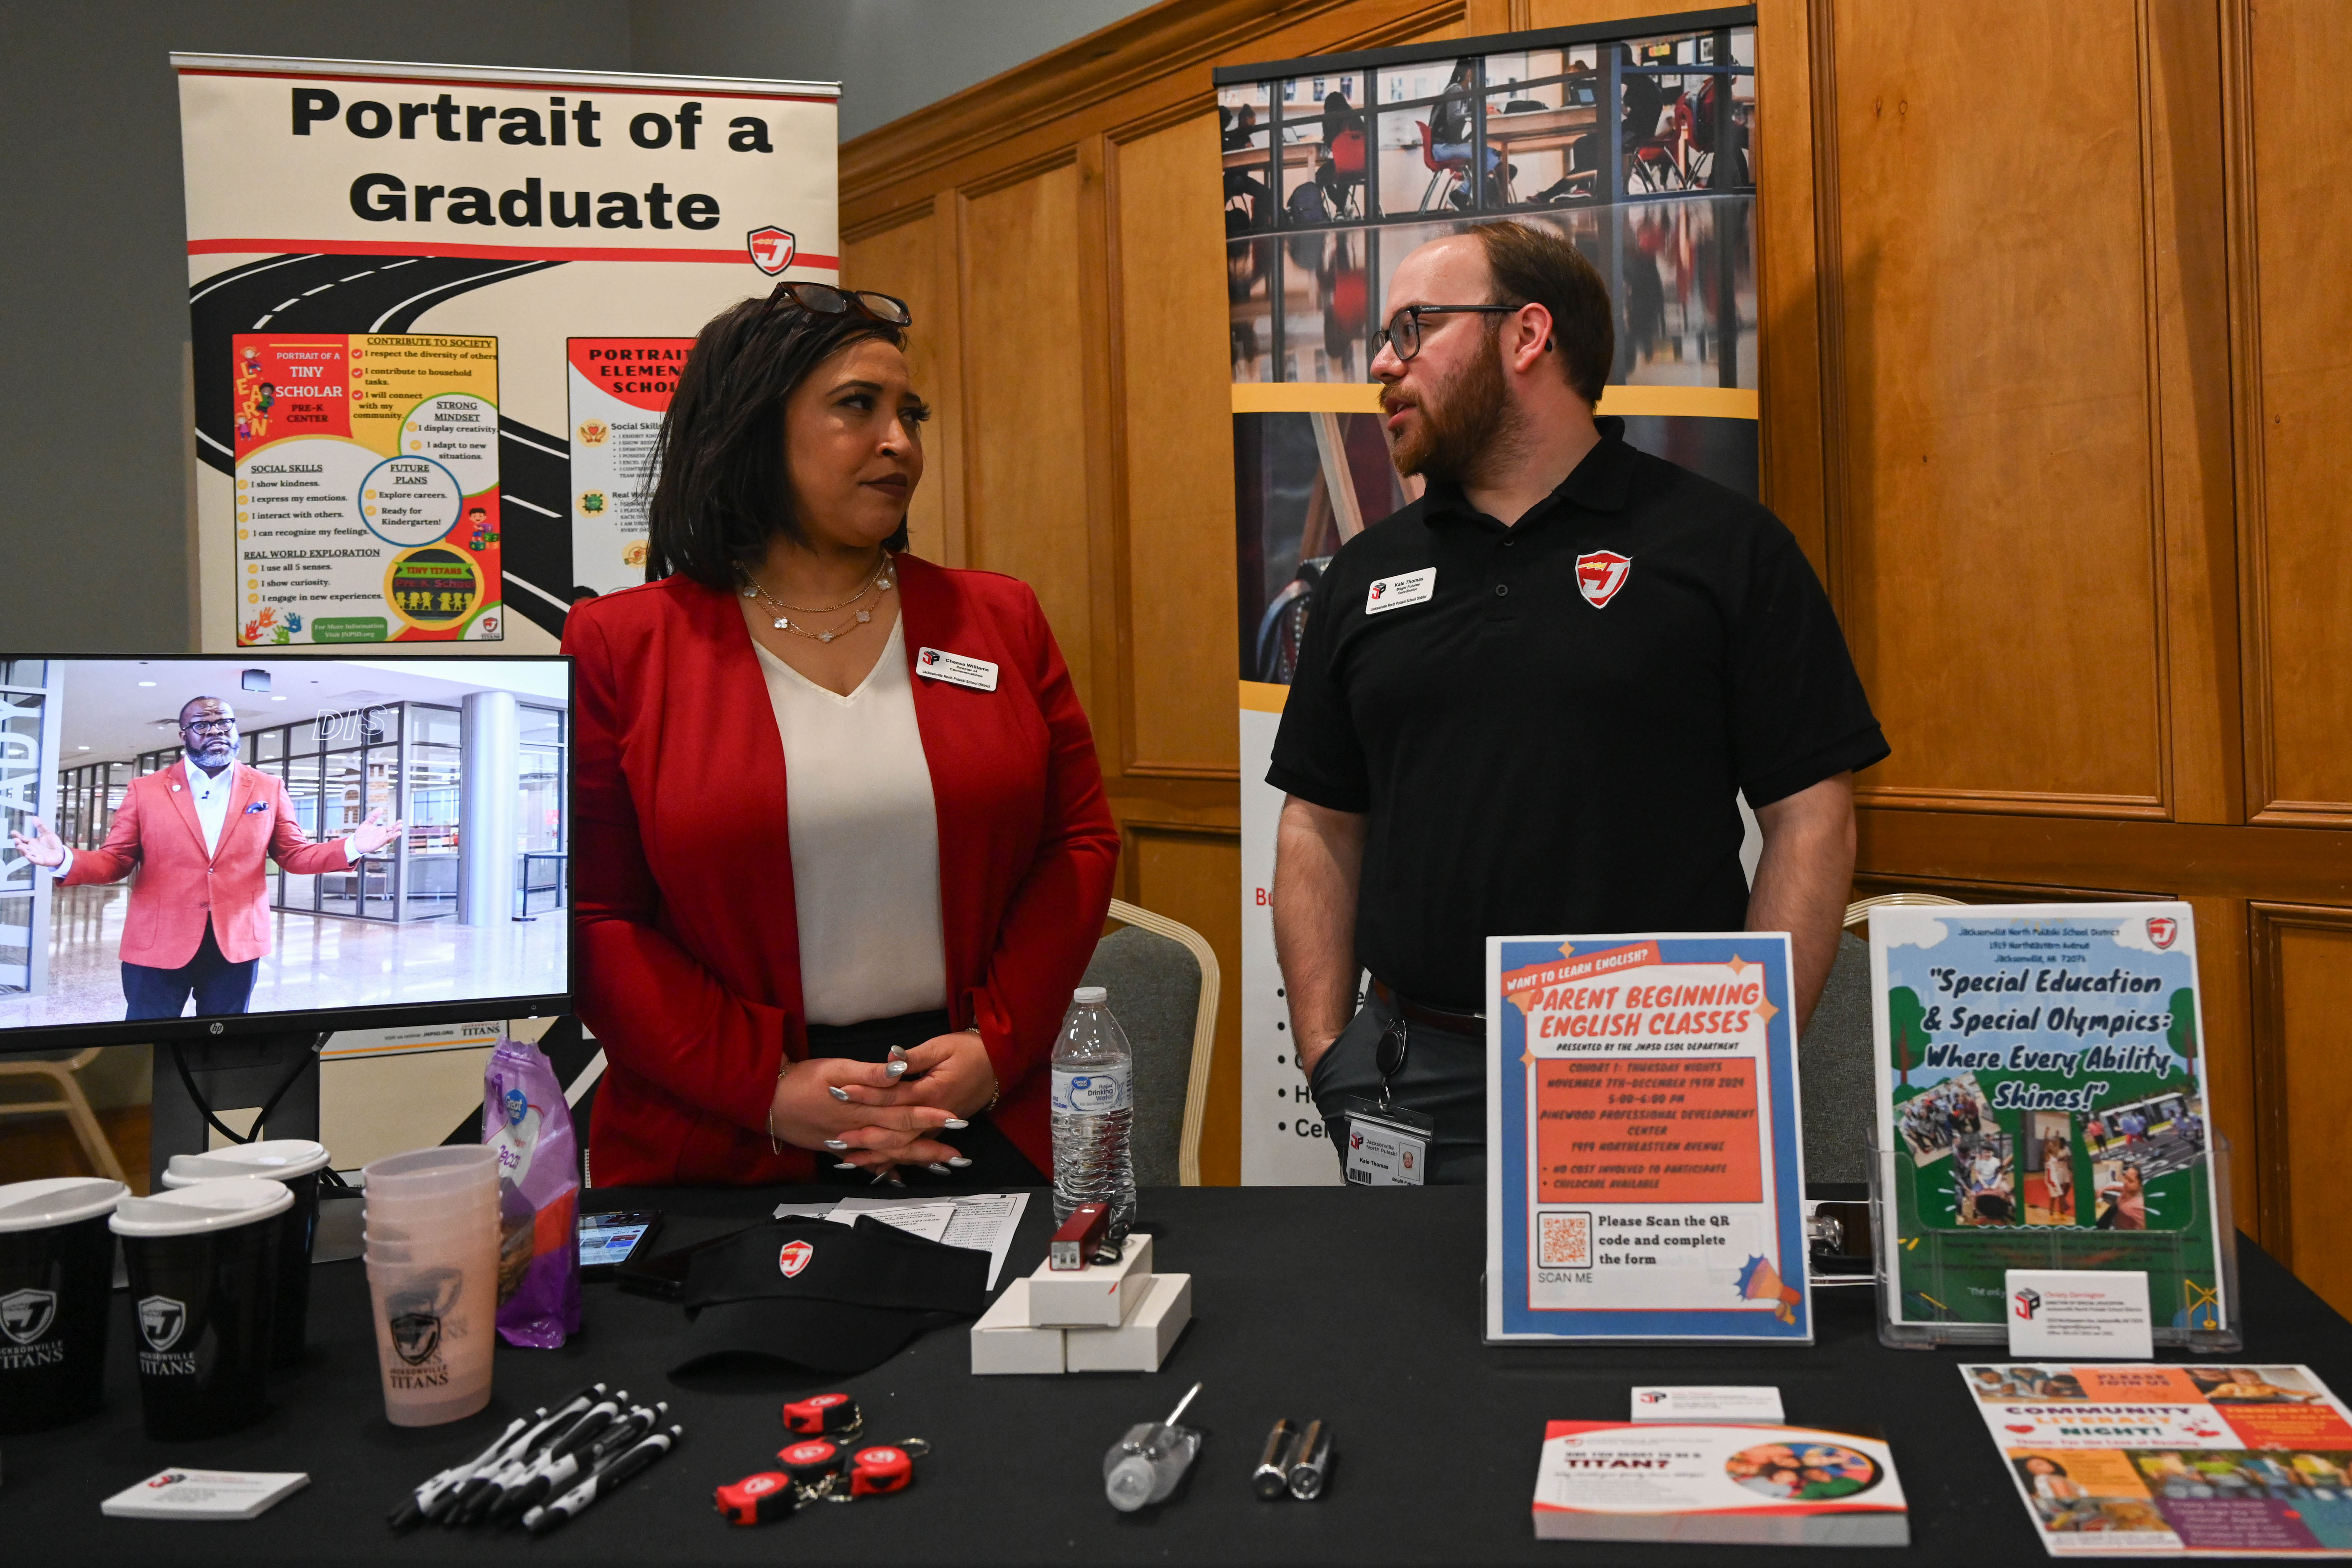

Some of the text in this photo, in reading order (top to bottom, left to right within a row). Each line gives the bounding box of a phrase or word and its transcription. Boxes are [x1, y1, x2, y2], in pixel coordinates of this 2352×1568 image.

[291, 87, 773, 153] Portrait of a
[349, 173, 720, 230] Graduate
[367, 337, 431, 346] CONTRIBUTE
[289, 366, 323, 378] TINY
[276, 386, 342, 397] SCHOLAR
[275, 529, 316, 537] recognize
[310, 549, 380, 557] EXPLORATION
[950, 668, 983, 678] Communications
[967, 663, 989, 672] Williams
[312, 704, 387, 741] DIS
[1507, 949, 1649, 991] WANT TO LEARN ENGLISH?
[1930, 968, 2161, 998] "Special Education
[1528, 983, 1759, 1012] PARENT BEGINNING
[1539, 1010, 1750, 1038] ENGLISH CLASSES
[1923, 1006, 2171, 1038] & Special Olympics:
[210, 1022, 224, 1034] hp
[461, 1026, 500, 1036] TITANS
[1557, 1042, 1739, 1051] PRESENTED BY THE JNPSD ESOL DEPARTMENT
[1926, 1045, 2170, 1077] Where Every Ability
[1719, 1077, 1744, 1087] 2024
[1994, 1081, 2107, 1109] Shines!"
[1600, 1109, 1755, 1119] PROFESSIONAL DEVELOPMENT
[1366, 1139, 1394, 1150] Jacksonville
[1381, 1148, 1397, 1156] Pulaski
[1371, 1161, 1389, 1169] Thomas
[1598, 1216, 1730, 1227] Please Scan the QR
[1599, 1235, 1725, 1248] code and complete
[1599, 1254, 1656, 1264] the form
[1538, 1273, 1593, 1283] SCAN ME
[390, 1373, 448, 1389] TITANS
[2059, 1427, 2163, 1435] NIGHT!
